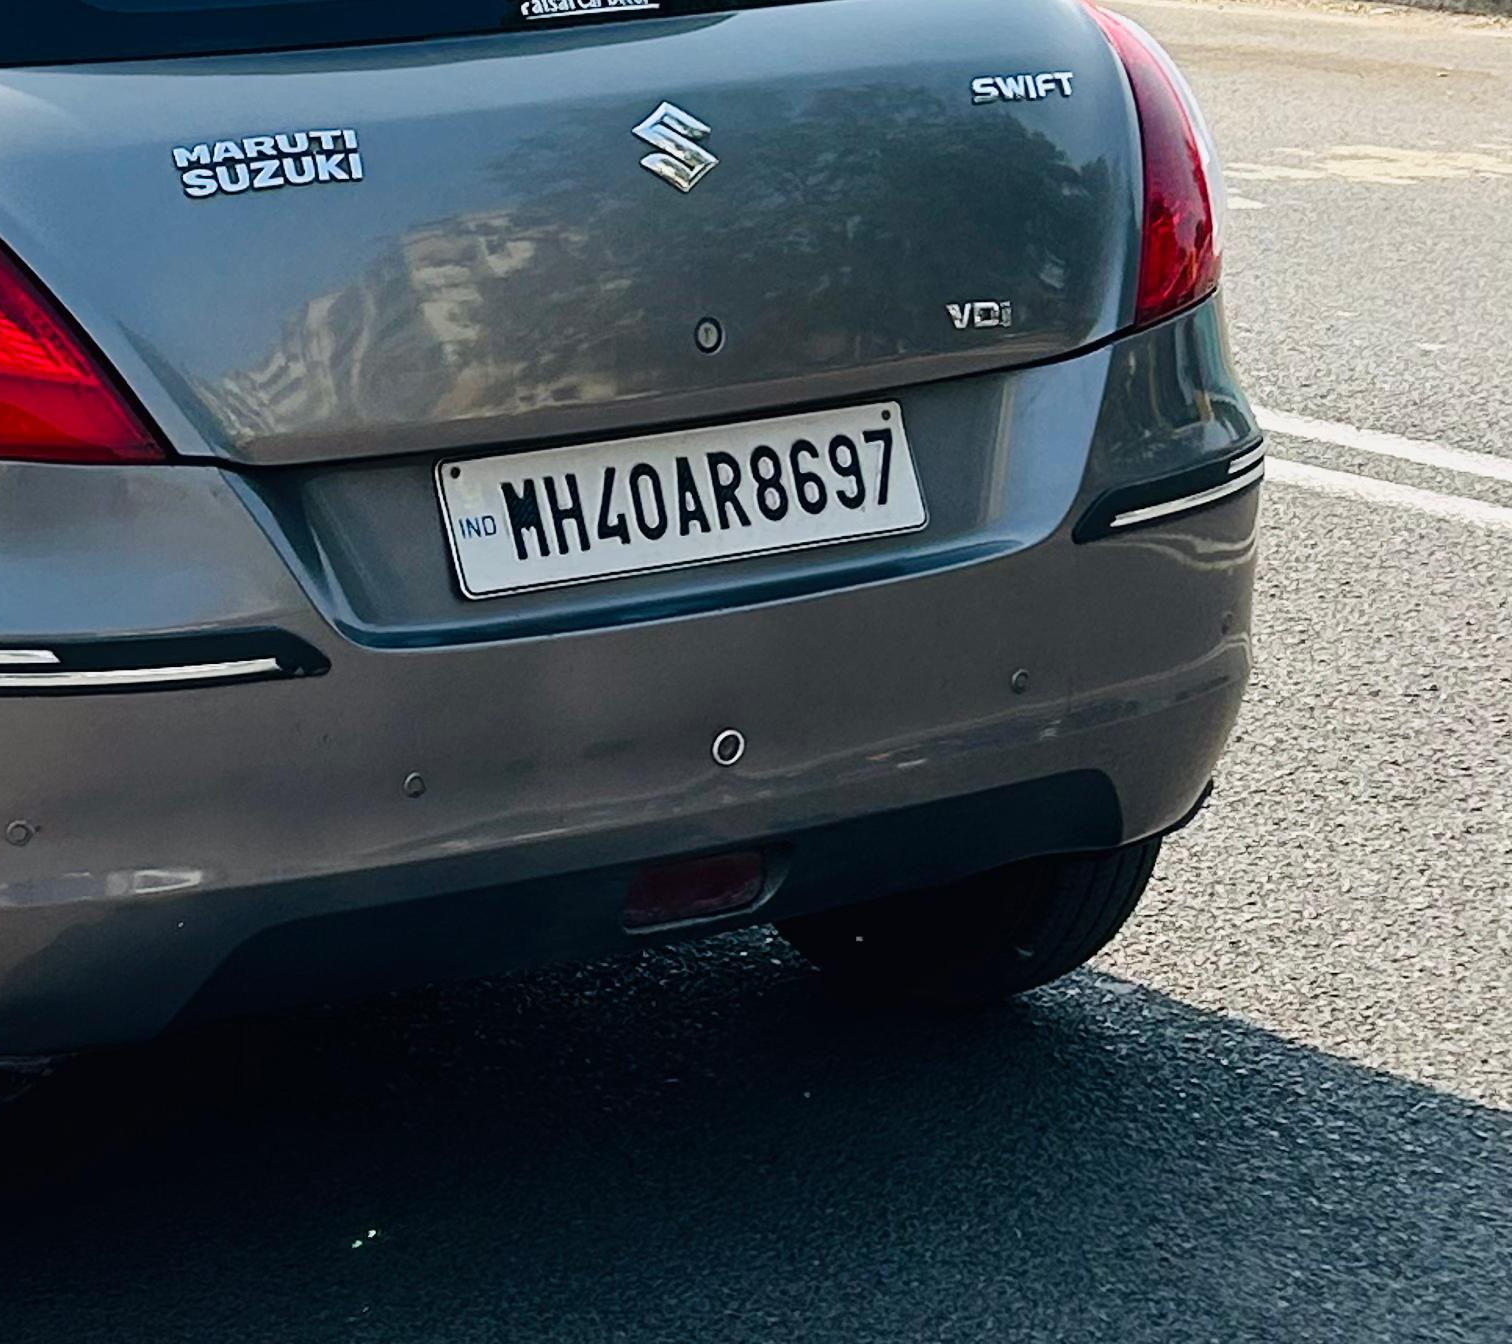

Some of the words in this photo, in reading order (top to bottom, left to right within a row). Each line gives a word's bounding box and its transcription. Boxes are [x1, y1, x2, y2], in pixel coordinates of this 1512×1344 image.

[971, 72, 1074, 104] SWIFT
[173, 129, 359, 168] MARUTI
[182, 152, 364, 198] SUZUKI
[458, 514, 497, 539] IND
[501, 428, 893, 560] MH40AR8697
